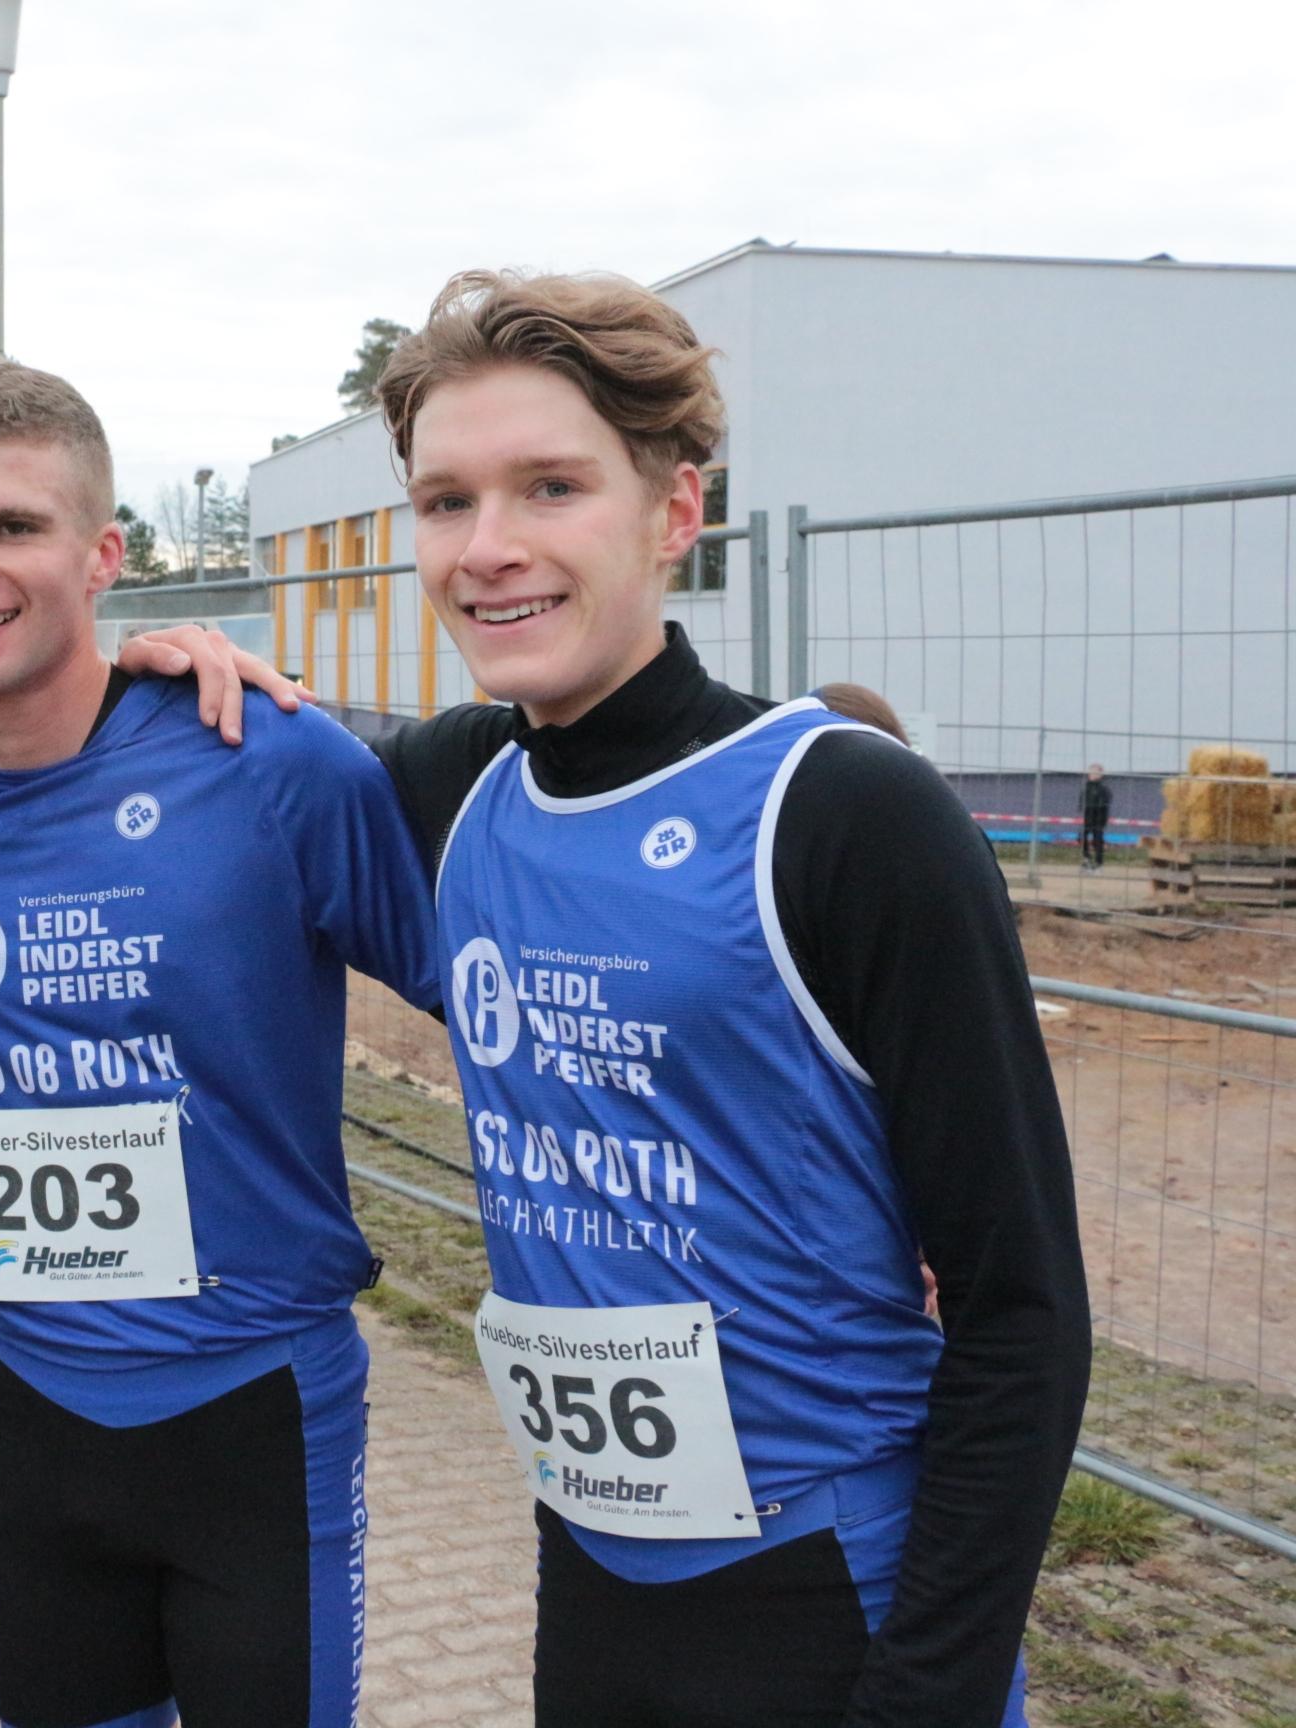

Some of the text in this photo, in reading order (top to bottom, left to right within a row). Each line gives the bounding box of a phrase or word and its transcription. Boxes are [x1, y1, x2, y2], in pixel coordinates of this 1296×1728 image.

[19, 885, 145, 908] Versicherungsbüro
[18, 908, 108, 941] LEIDL
[19, 935, 163, 973] INDERST
[520, 944, 650, 973] Versicherungsbüro
[22, 970, 150, 1006] PFEIFER
[517, 967, 608, 1011] LEIDL
[527, 1008, 668, 1058] NDERST
[10, 1043, 59, 1095] 08
[71, 1034, 183, 1091] ROTH
[575, 1129, 697, 1206] ROTH
[22, 1246, 129, 1275] Hueber
[95, 1271, 111, 1280] Am
[480, 1316, 700, 1362] Hueber-Silvesterlauf
[509, 1363, 677, 1459] 356
[563, 1466, 668, 1503] Hueber
[632, 1507, 650, 1518] Am
